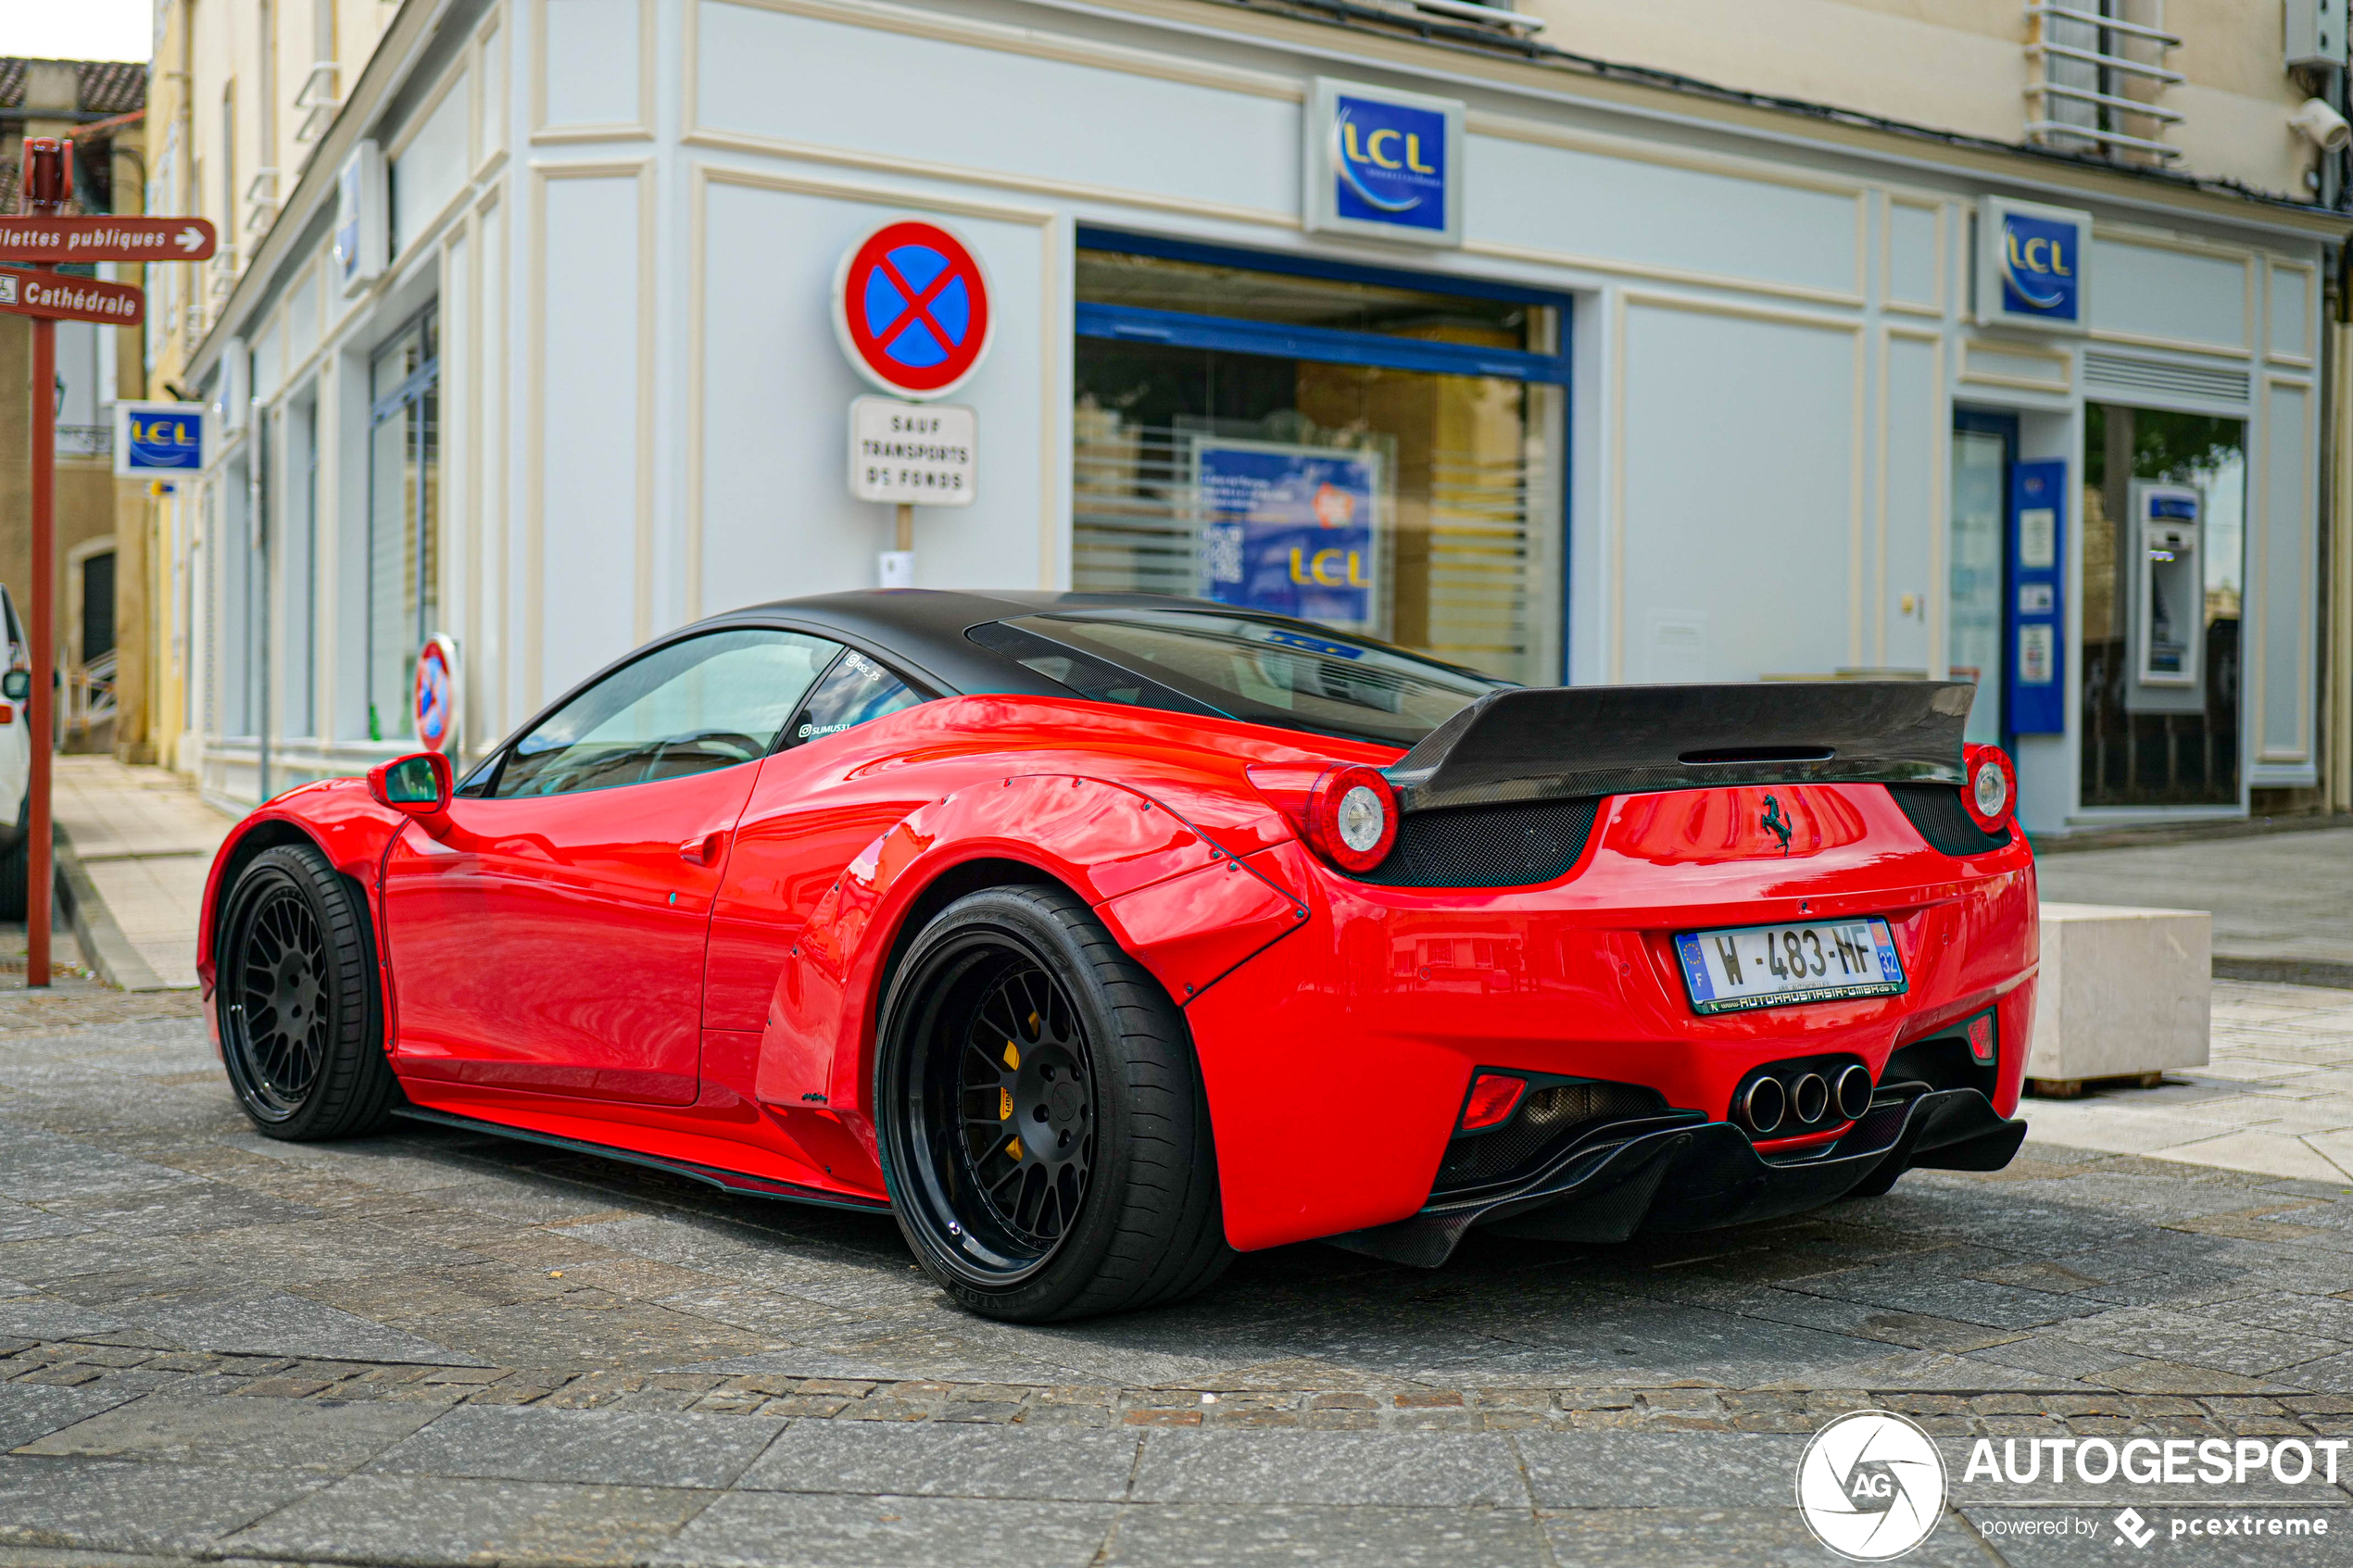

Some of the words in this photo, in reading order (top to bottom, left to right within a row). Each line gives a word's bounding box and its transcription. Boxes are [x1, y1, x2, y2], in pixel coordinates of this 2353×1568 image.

[1344, 122, 1435, 174] LCL
[67, 229, 166, 250] publiques
[2008, 233, 2070, 276] LCL
[25, 282, 136, 317] Cathédrale
[131, 420, 197, 445] LCL
[891, 416, 939, 433] SAUF
[862, 439, 969, 464] TRANSPORTS
[900, 469, 963, 490] FONDS
[1290, 547, 1371, 587] LCL
[1879, 952, 1898, 973] 32
[1694, 972, 1703, 987] F
